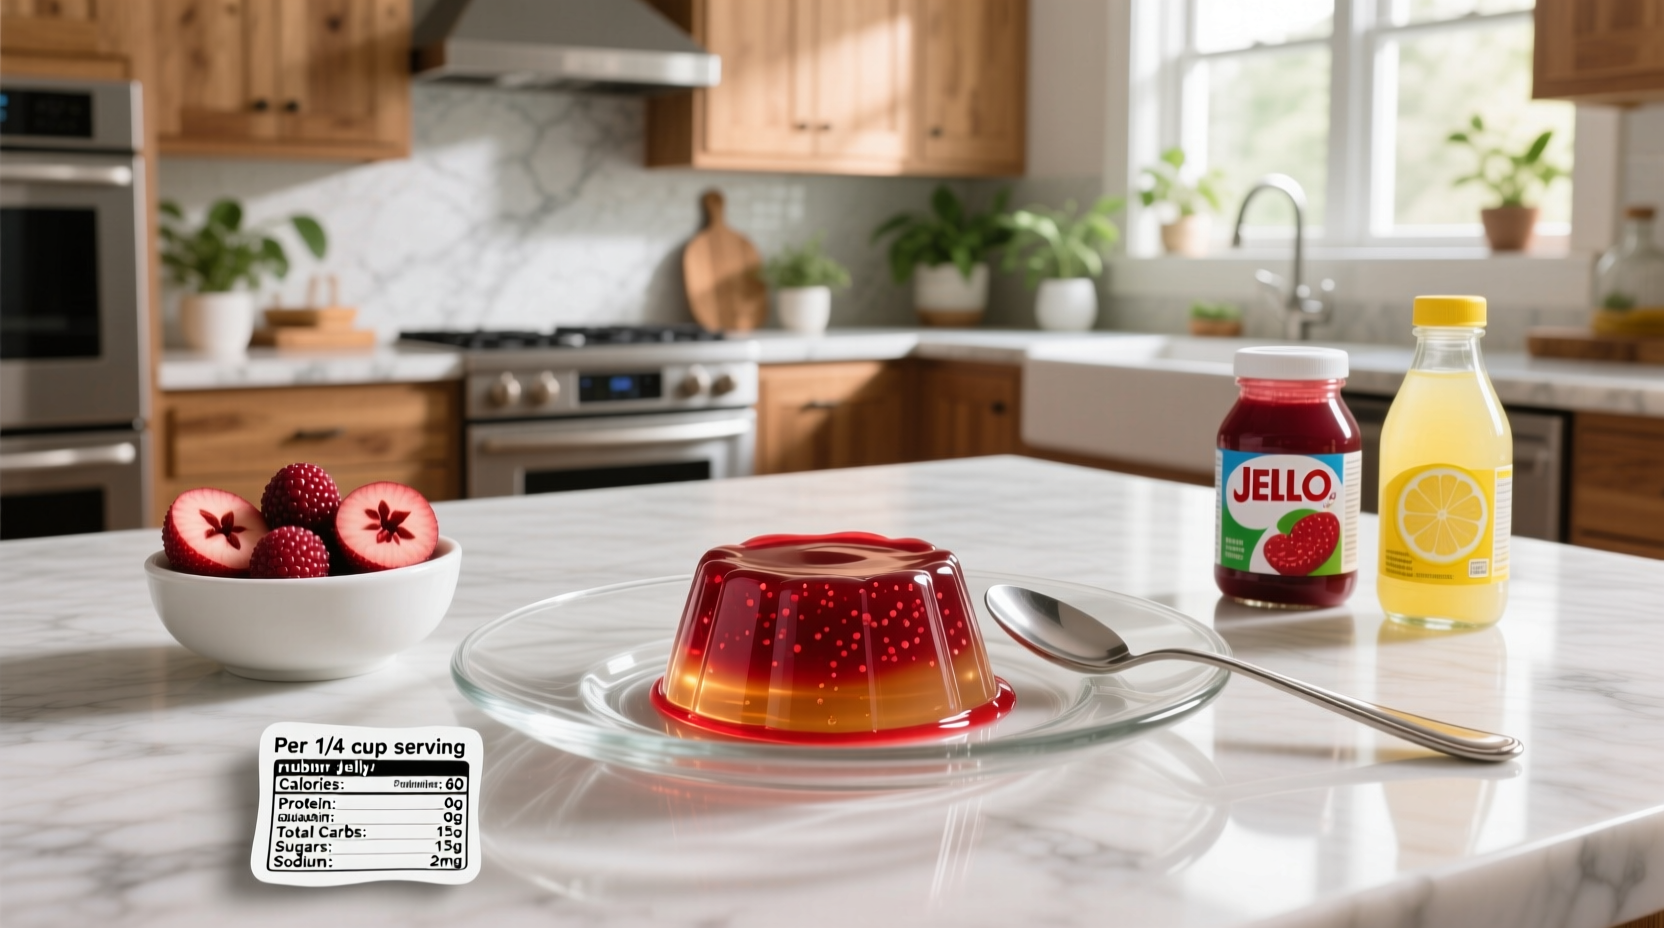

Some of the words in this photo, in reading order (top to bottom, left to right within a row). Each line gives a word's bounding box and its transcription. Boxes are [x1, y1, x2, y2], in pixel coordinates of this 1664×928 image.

[1233, 467, 1332, 503] JELLO
[274, 737, 308, 754] Per
[315, 736, 345, 756] 1/4
[351, 741, 388, 758] cup
[394, 738, 466, 759] serving
[279, 777, 345, 790] Calories:
[445, 777, 464, 790] 60
[278, 797, 336, 810] Protein:
[444, 797, 463, 811] 0g
[443, 811, 463, 825] 0g
[276, 825, 314, 838] Total
[318, 824, 367, 838] Carbs:
[274, 841, 332, 856] Sugars:
[435, 840, 462, 854] 15g
[430, 855, 462, 869] 2mg
